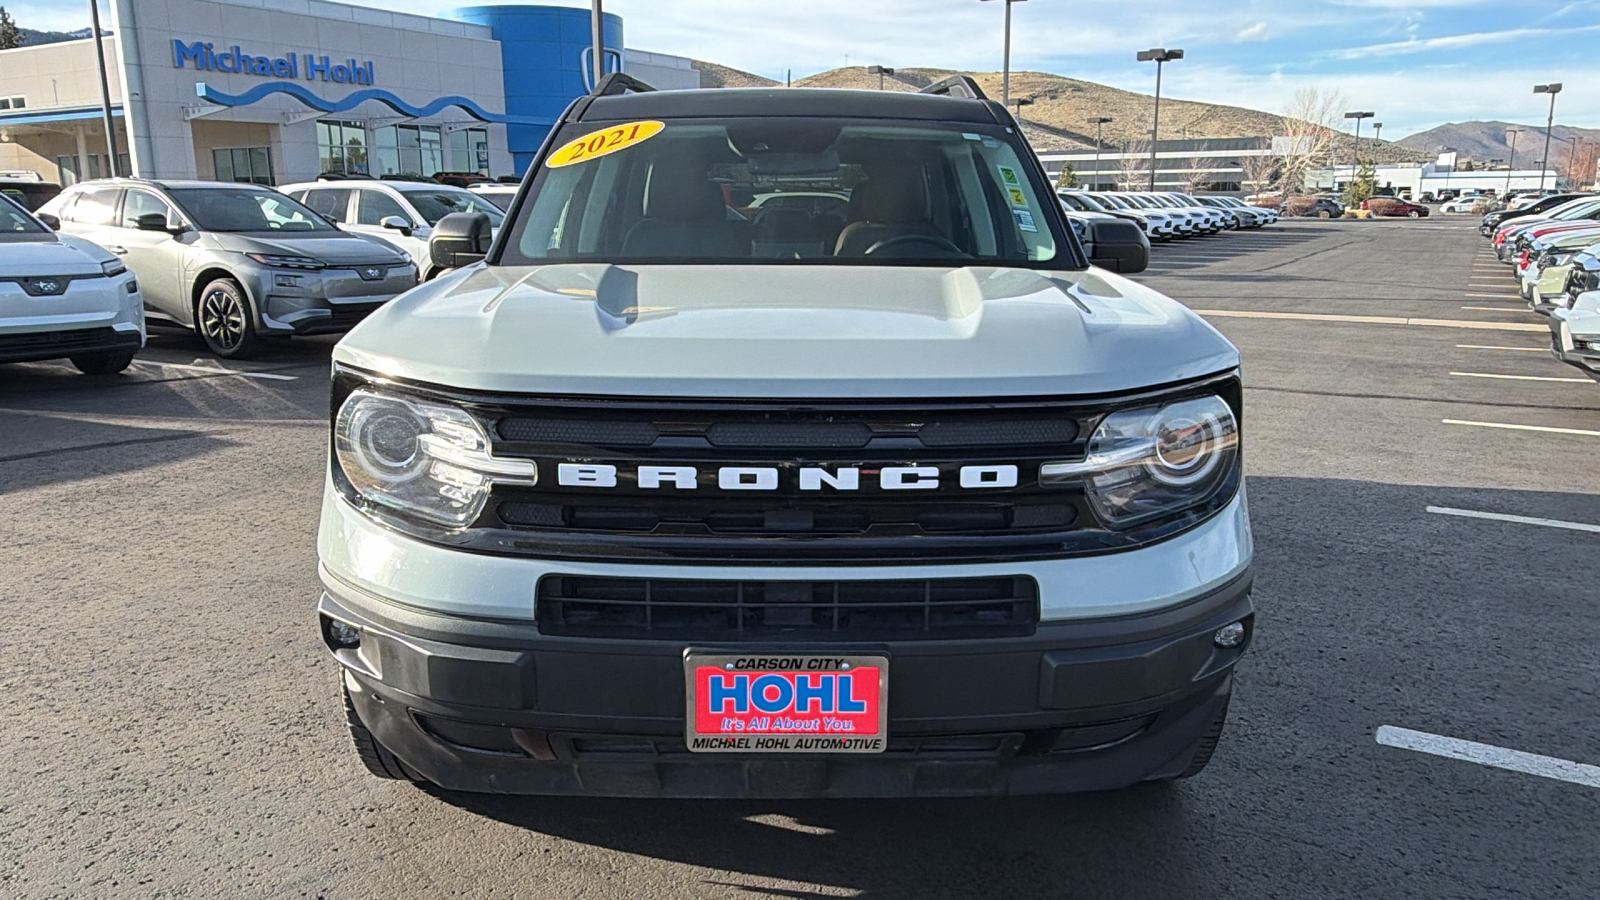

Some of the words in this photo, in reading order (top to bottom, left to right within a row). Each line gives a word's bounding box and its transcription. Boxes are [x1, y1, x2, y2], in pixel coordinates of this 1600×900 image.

[172, 38, 298, 78] Michael
[304, 53, 375, 85] Hohl
[567, 124, 641, 161] 2021
[557, 462, 1019, 491] BRONCO
[735, 658, 803, 670] CARSON
[807, 658, 844, 670] CITY
[708, 673, 867, 713] HOHL
[720, 716, 745, 730] It's
[748, 716, 769, 730] All
[771, 716, 819, 730] About
[692, 737, 750, 750] MICHAEL
[755, 738, 791, 750] HOHL
[793, 737, 882, 750] AUTOMOTIVE
